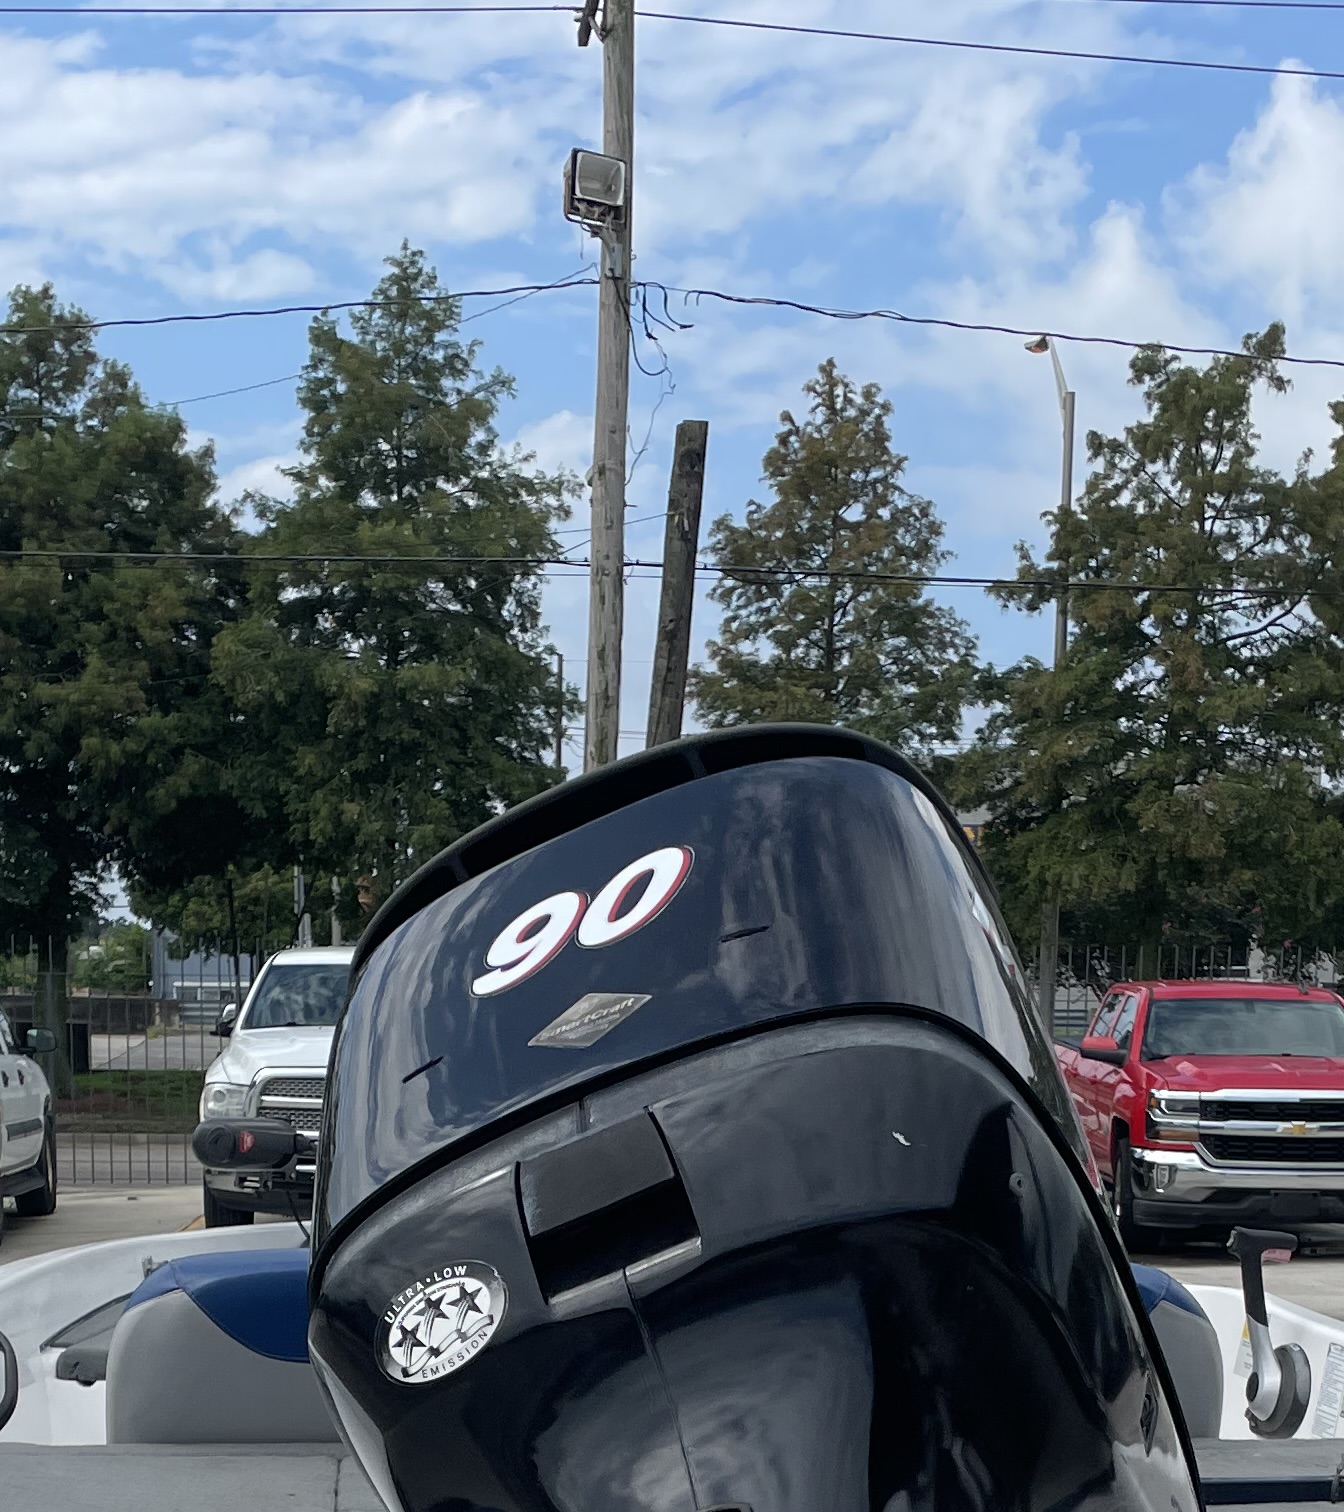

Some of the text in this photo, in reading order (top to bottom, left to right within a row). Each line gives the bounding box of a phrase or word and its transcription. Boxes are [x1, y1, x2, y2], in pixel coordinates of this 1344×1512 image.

[470, 845, 695, 998] 90
[384, 1281, 425, 1325] ULTRA
[433, 1265, 468, 1283] LOW
[421, 1330, 488, 1379] EMISSION
